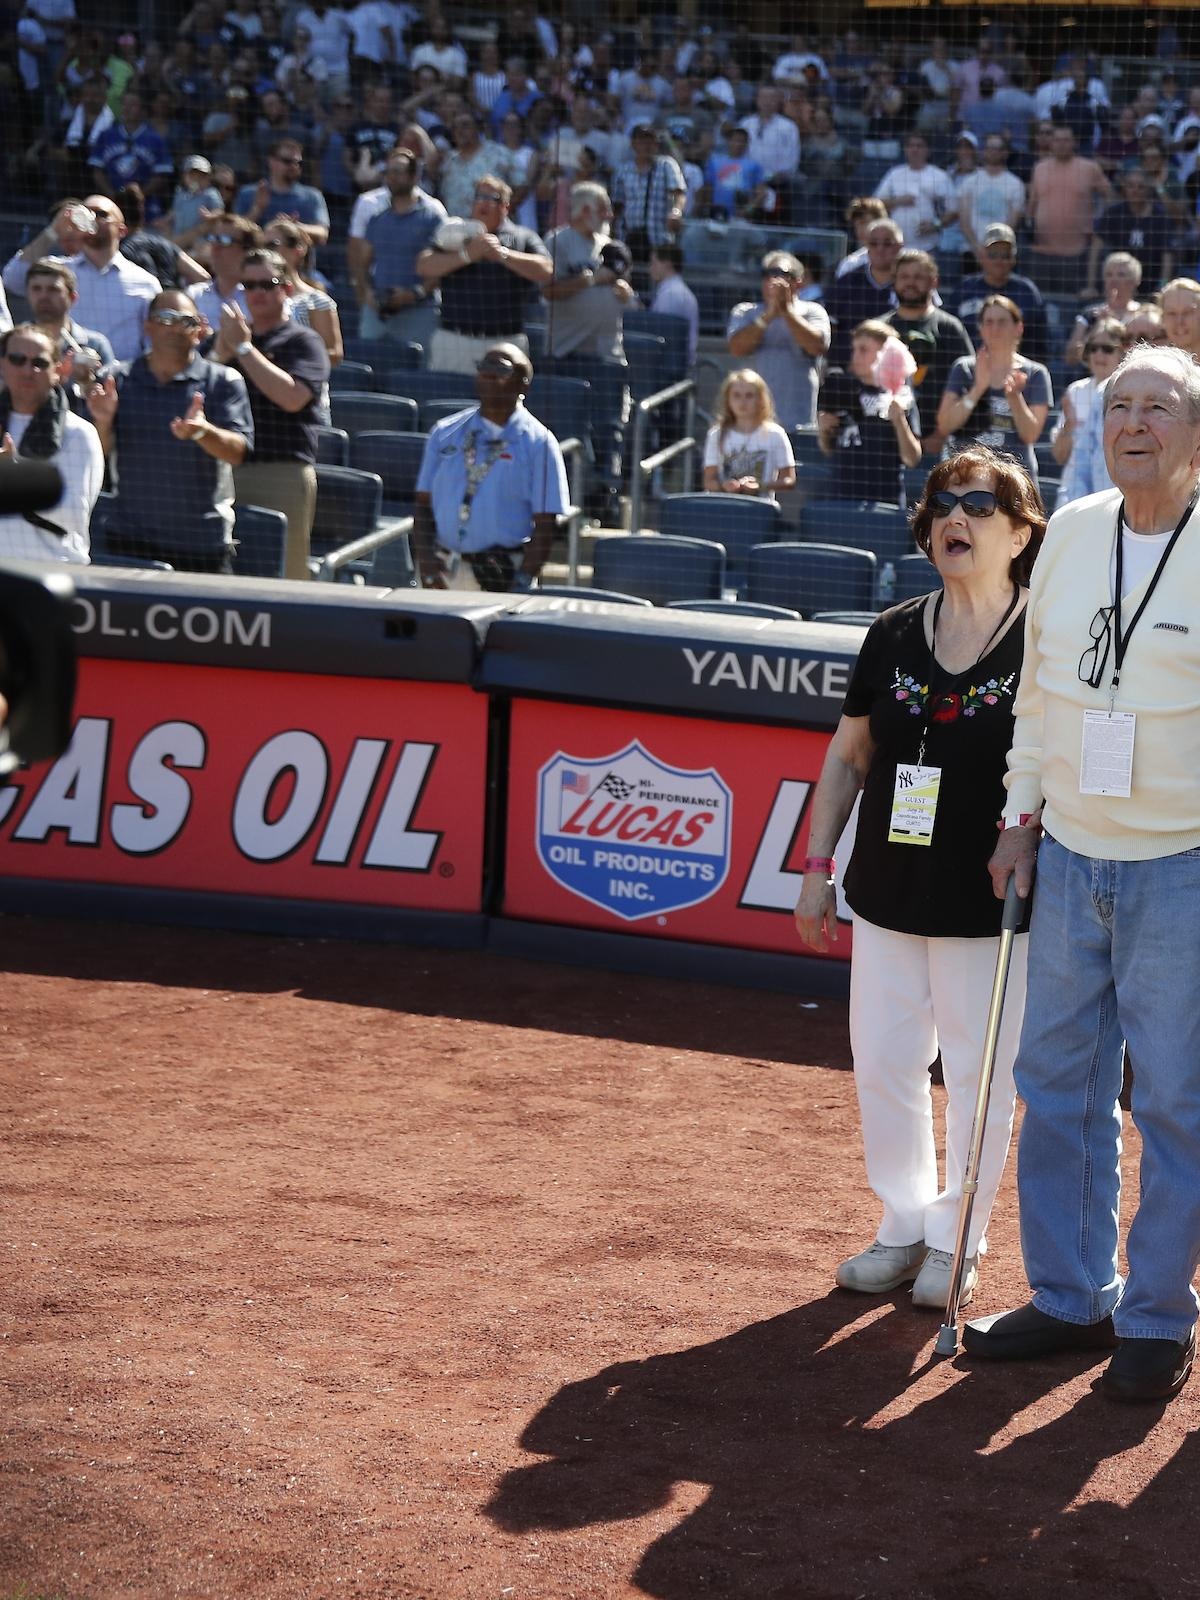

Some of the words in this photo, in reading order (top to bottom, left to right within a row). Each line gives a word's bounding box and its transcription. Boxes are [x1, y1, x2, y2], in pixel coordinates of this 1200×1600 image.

[0, 716, 208, 858] AS
[232, 728, 441, 875] OIL
[638, 791, 720, 808] PERFORMANCE
[560, 799, 715, 847] LUCAS
[549, 845, 587, 866] OIL
[593, 850, 716, 882] PRODUCTS
[609, 878, 656, 901] INC.
